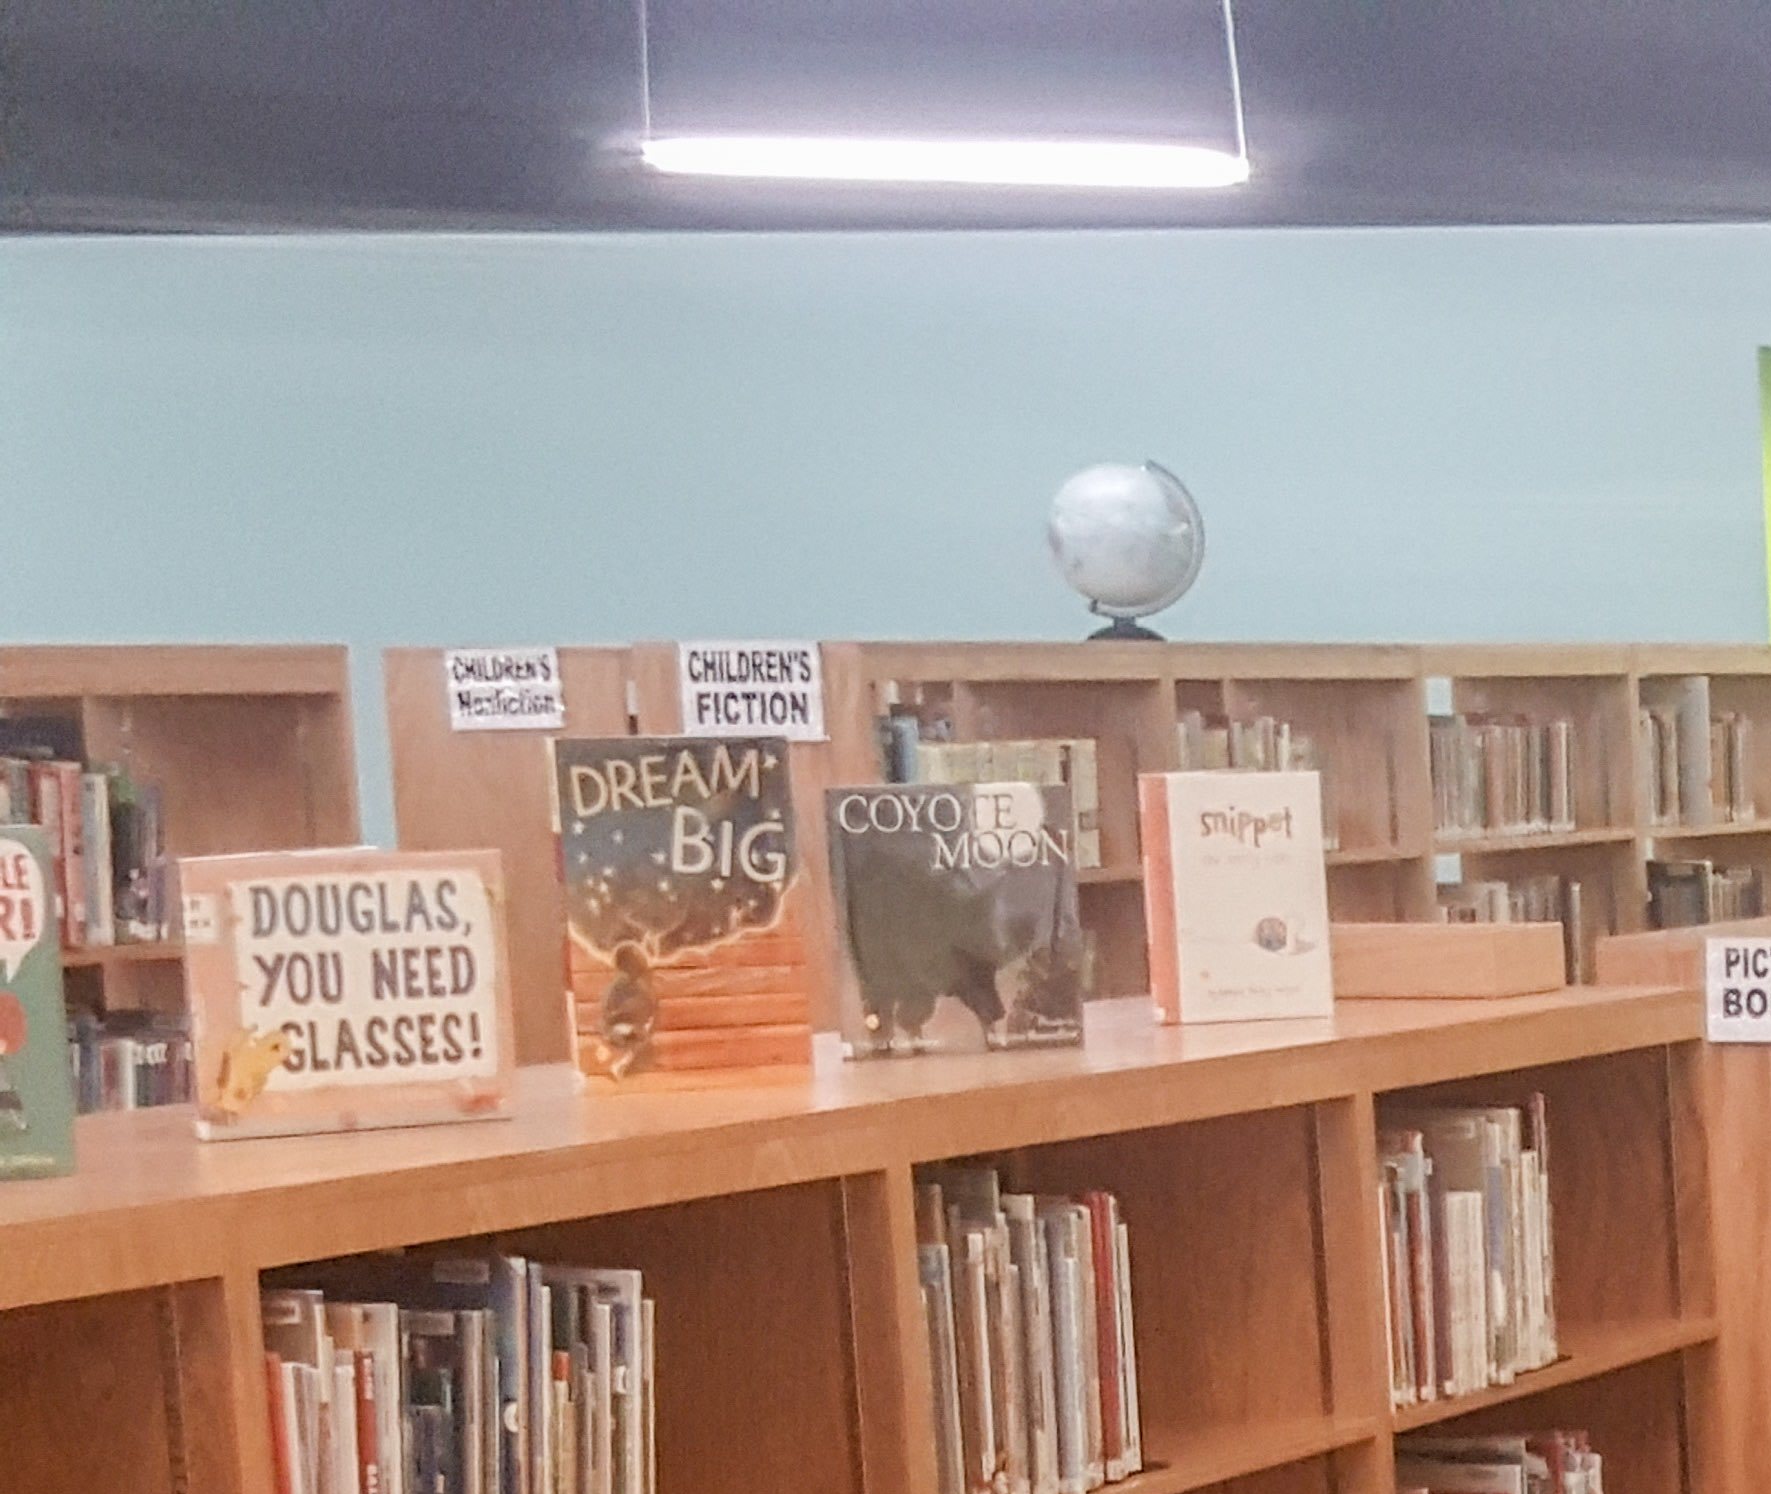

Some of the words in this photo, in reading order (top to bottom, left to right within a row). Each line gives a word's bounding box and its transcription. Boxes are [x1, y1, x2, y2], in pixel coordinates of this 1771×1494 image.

[688, 650, 812, 684] CHILDREN'S
[696, 691, 810, 725] FICTION
[569, 744, 760, 818] DREAM
[671, 804, 787, 883] BIG
[931, 829, 1070, 870] MOON
[1200, 805, 1293, 848] snippet
[248, 879, 472, 938] DOUGLAS,
[252, 951, 344, 1007] YOU
[371, 945, 476, 1001] NEED
[280, 1012, 483, 1074] GLASSES!
